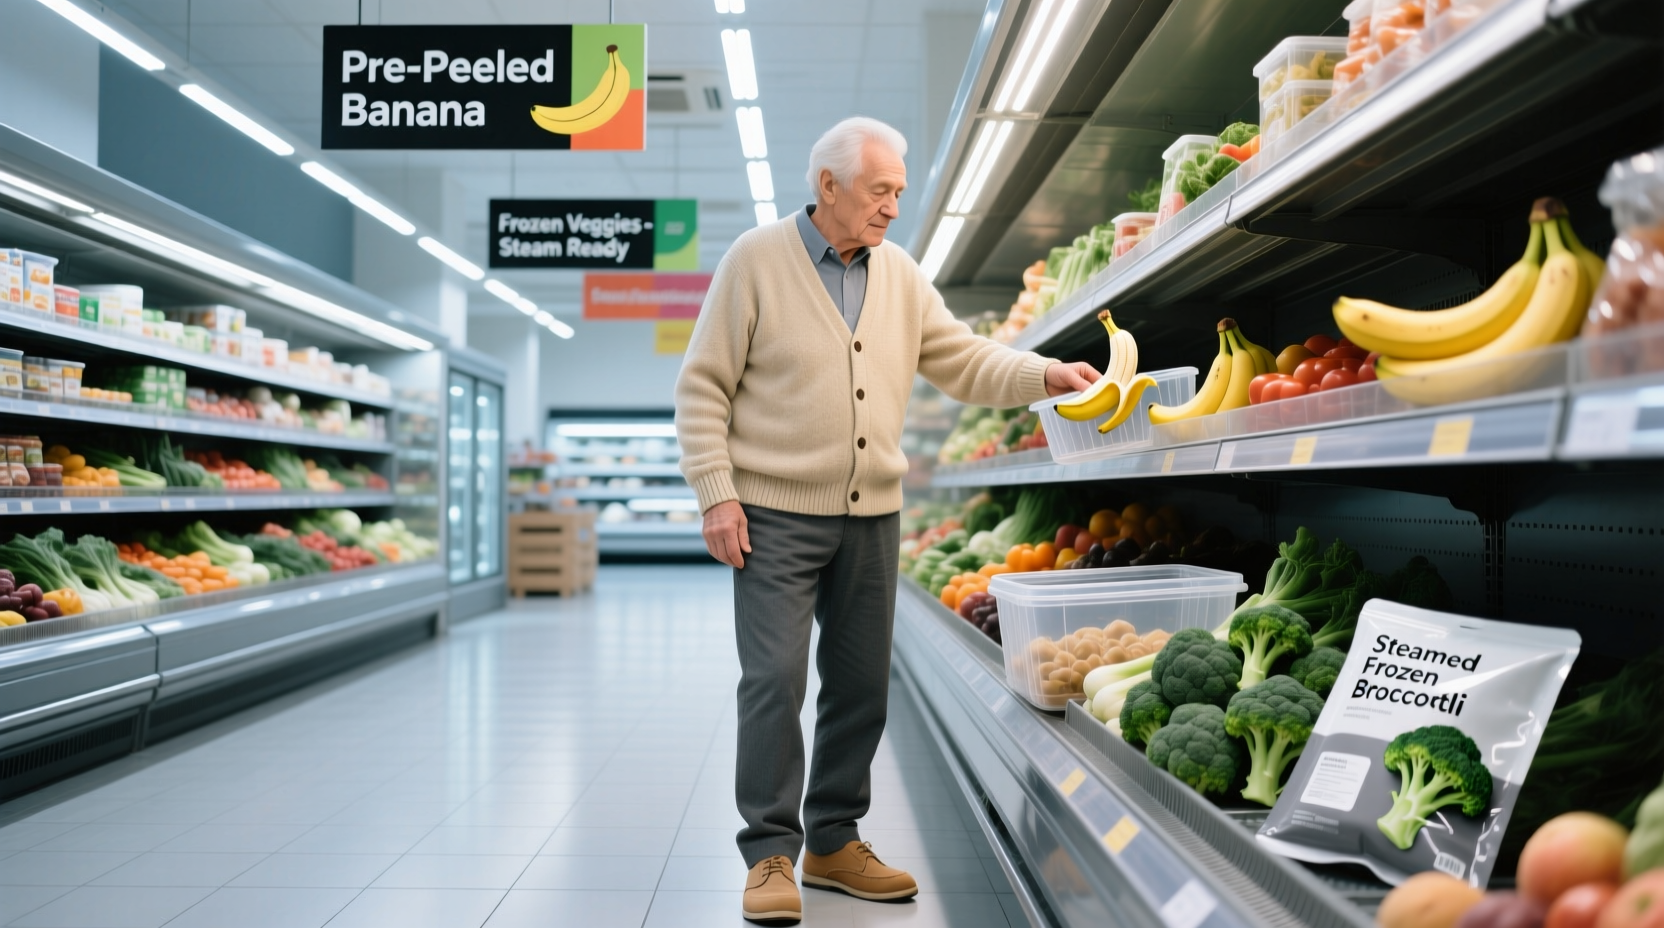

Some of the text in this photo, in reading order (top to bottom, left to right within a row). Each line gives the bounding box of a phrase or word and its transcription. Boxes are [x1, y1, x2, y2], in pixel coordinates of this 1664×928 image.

[341, 48, 554, 84] Pre-Peeled
[341, 92, 486, 127] Banana
[498, 212, 564, 234] Frozen
[498, 236, 631, 263] Steam Ready
[1372, 634, 1482, 673] Steamed
[1362, 656, 1439, 687] Frozen
